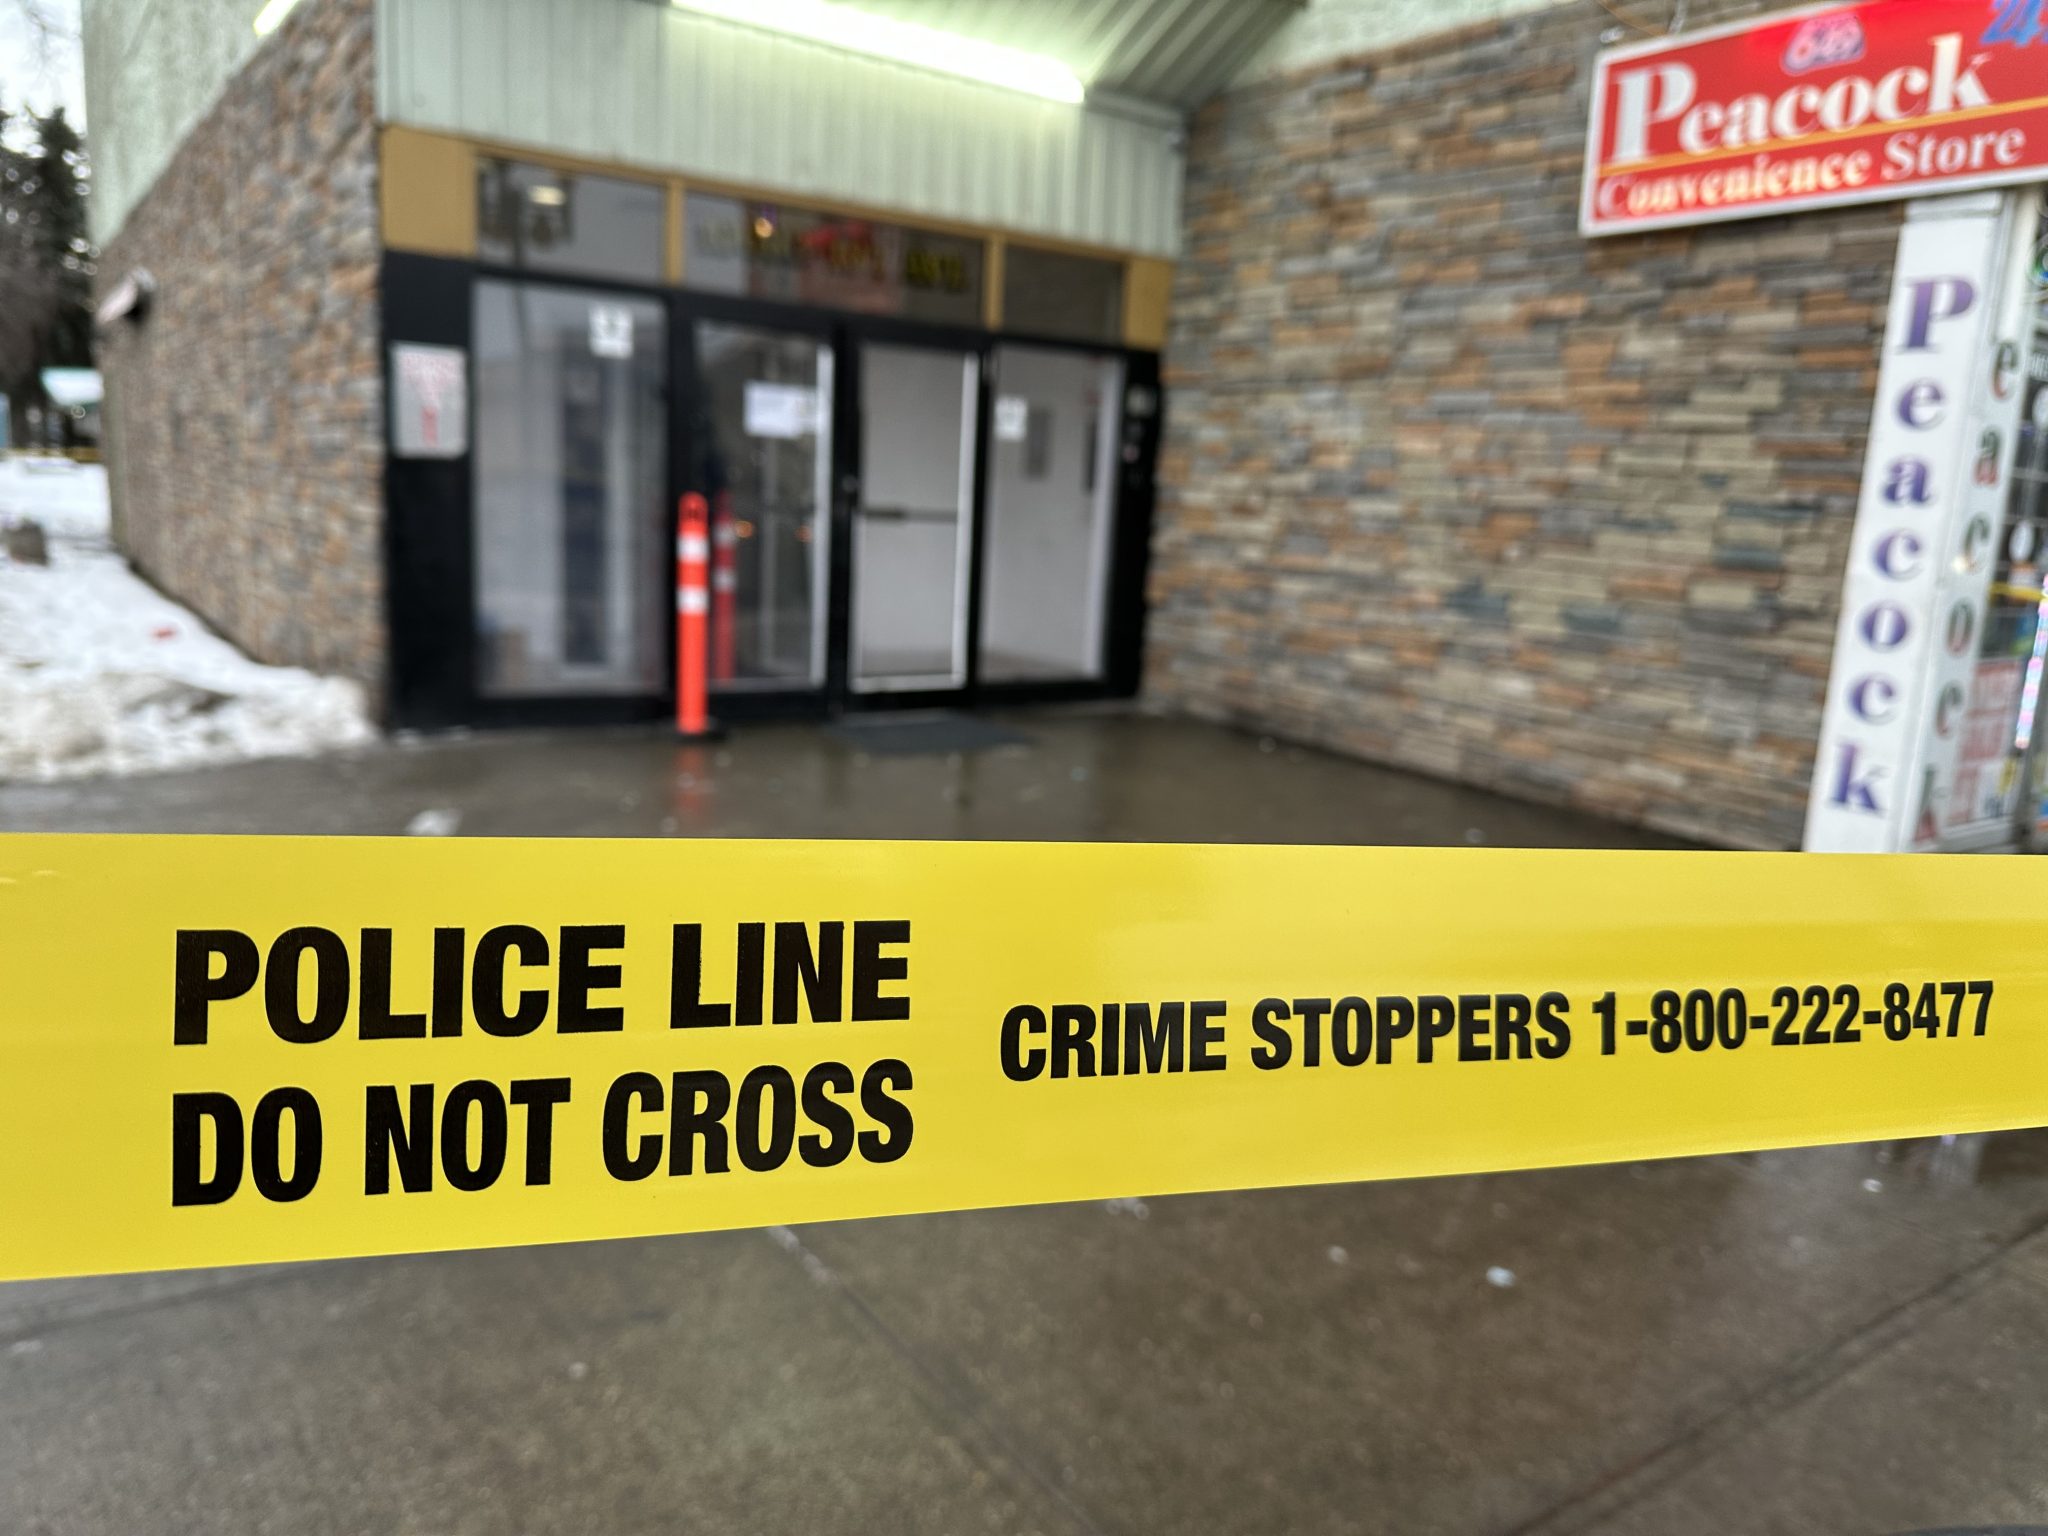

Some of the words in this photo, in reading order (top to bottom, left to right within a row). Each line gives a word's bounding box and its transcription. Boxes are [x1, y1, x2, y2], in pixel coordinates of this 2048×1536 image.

[1611, 32, 1992, 164] Peacock
[1600, 149, 1872, 219] Convenience
[1882, 127, 2026, 181] Store
[1829, 274, 1978, 818] Peacock
[174, 924, 625, 1046] POLICE
[670, 919, 911, 1030] LINE
[1000, 1000, 1227, 1082] CRIME
[1250, 991, 1571, 1071] STOPPERS
[1592, 980, 1994, 1056] 1-800-222-8477
[172, 1086, 323, 1207] DO
[364, 1077, 572, 1196] NOT
[602, 1058, 914, 1182] CROSS
